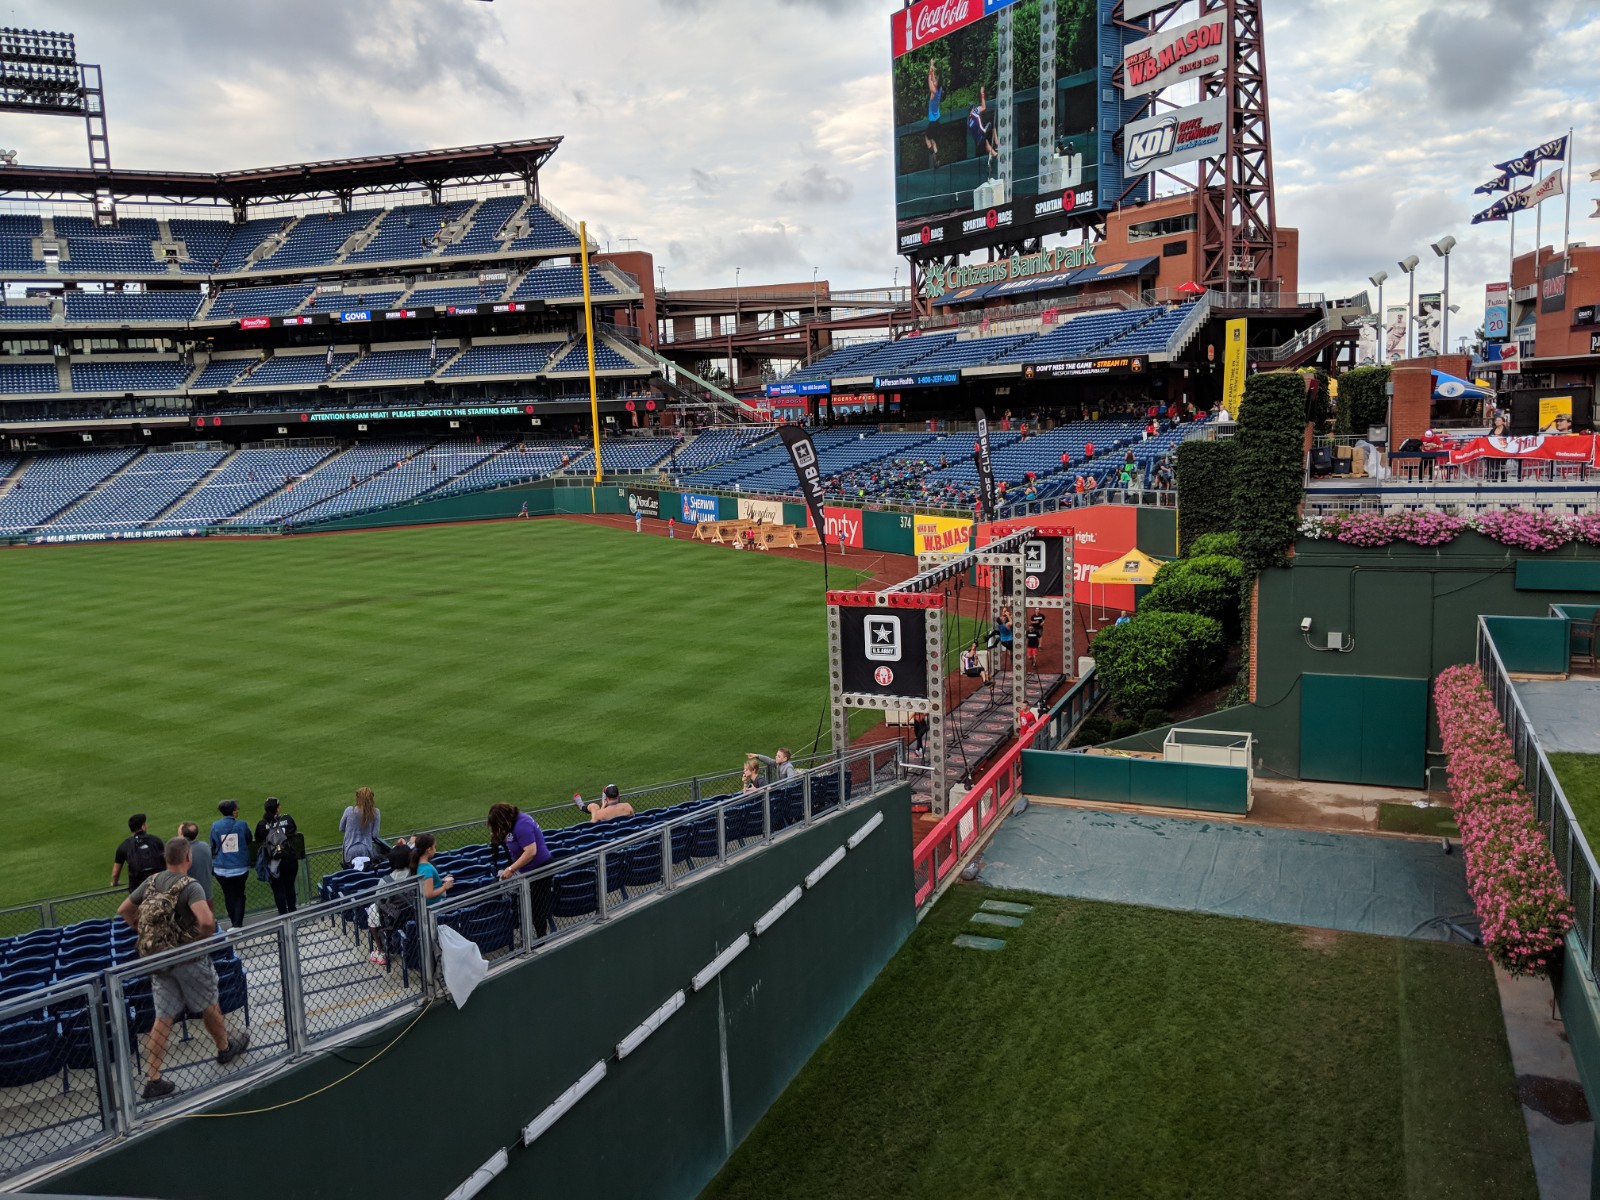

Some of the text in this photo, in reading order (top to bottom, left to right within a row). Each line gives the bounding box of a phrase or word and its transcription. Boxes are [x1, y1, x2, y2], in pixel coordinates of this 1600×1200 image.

[1178, 60, 1202, 73] SINCE
[1179, 117, 1203, 131] OFFICE
[1177, 122, 1222, 144] TECHNOLOGY
[1035, 190, 1094, 214] SPARTAN RACE
[962, 210, 1013, 231] SPARTAN RACE
[900, 227, 944, 247] SPARTAN RACE
[947, 239, 1097, 290] Citizens Bank Park
[1542, 275, 1566, 299] GIANT
[344, 312, 367, 321] GOYA
[1489, 319, 1504, 332] 20
[1036, 364, 1053, 372] DON'T
[1052, 363, 1064, 371] MISS
[1096, 360, 1120, 368] STREAM
[310, 413, 345, 421] ATTENTION
[392, 410, 416, 418] PLEASE
[416, 409, 441, 417] REPORT
[980, 437, 991, 473] CLIMB
[636, 495, 659, 509] NovaCare
[690, 496, 715, 511] SHERWIN
[900, 516, 912, 528] 374
[916, 525, 937, 533] WHO BUT
[66, 533, 106, 541] NETWORK
[143, 529, 183, 538] NETWORK
